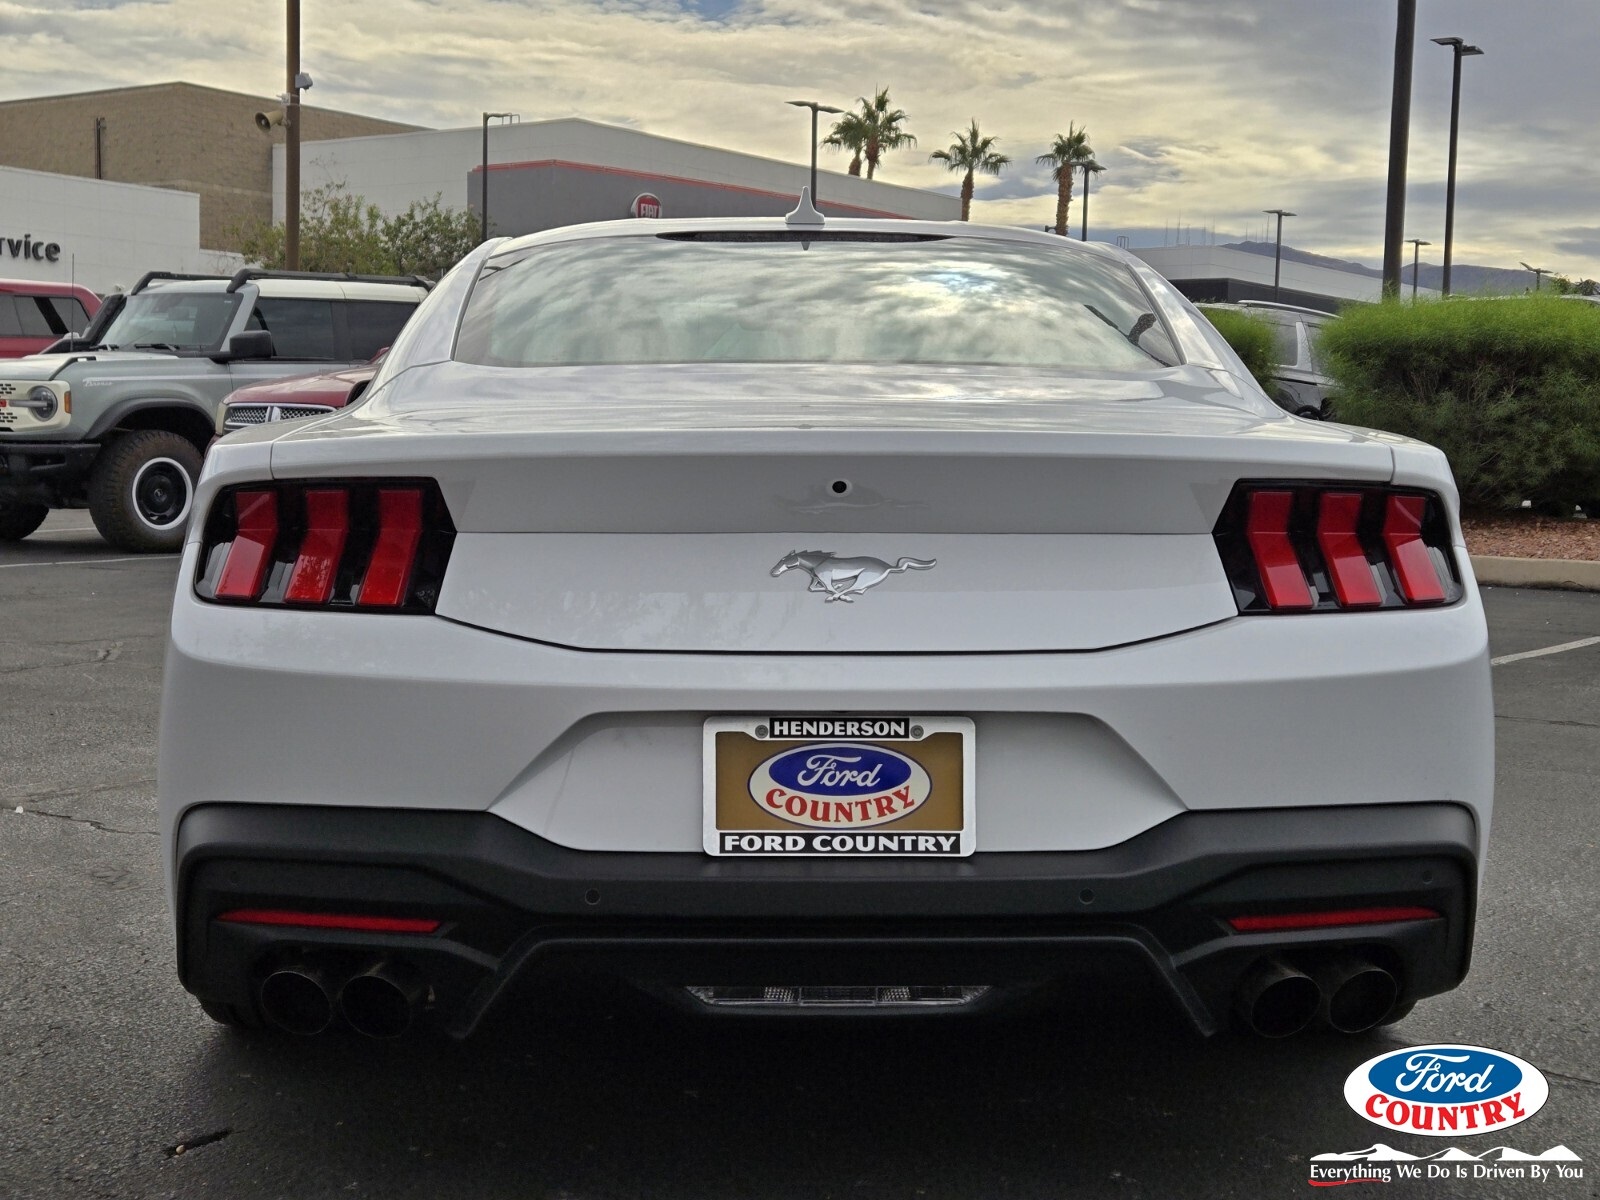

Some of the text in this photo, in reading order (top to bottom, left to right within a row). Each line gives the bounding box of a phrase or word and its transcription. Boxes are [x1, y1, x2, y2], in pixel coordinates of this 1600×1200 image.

[773, 721, 906, 736] HENDERSON
[797, 754, 883, 787] Ford
[765, 785, 915, 822] COUNTRY
[724, 835, 957, 852] FORD COUNTRY
